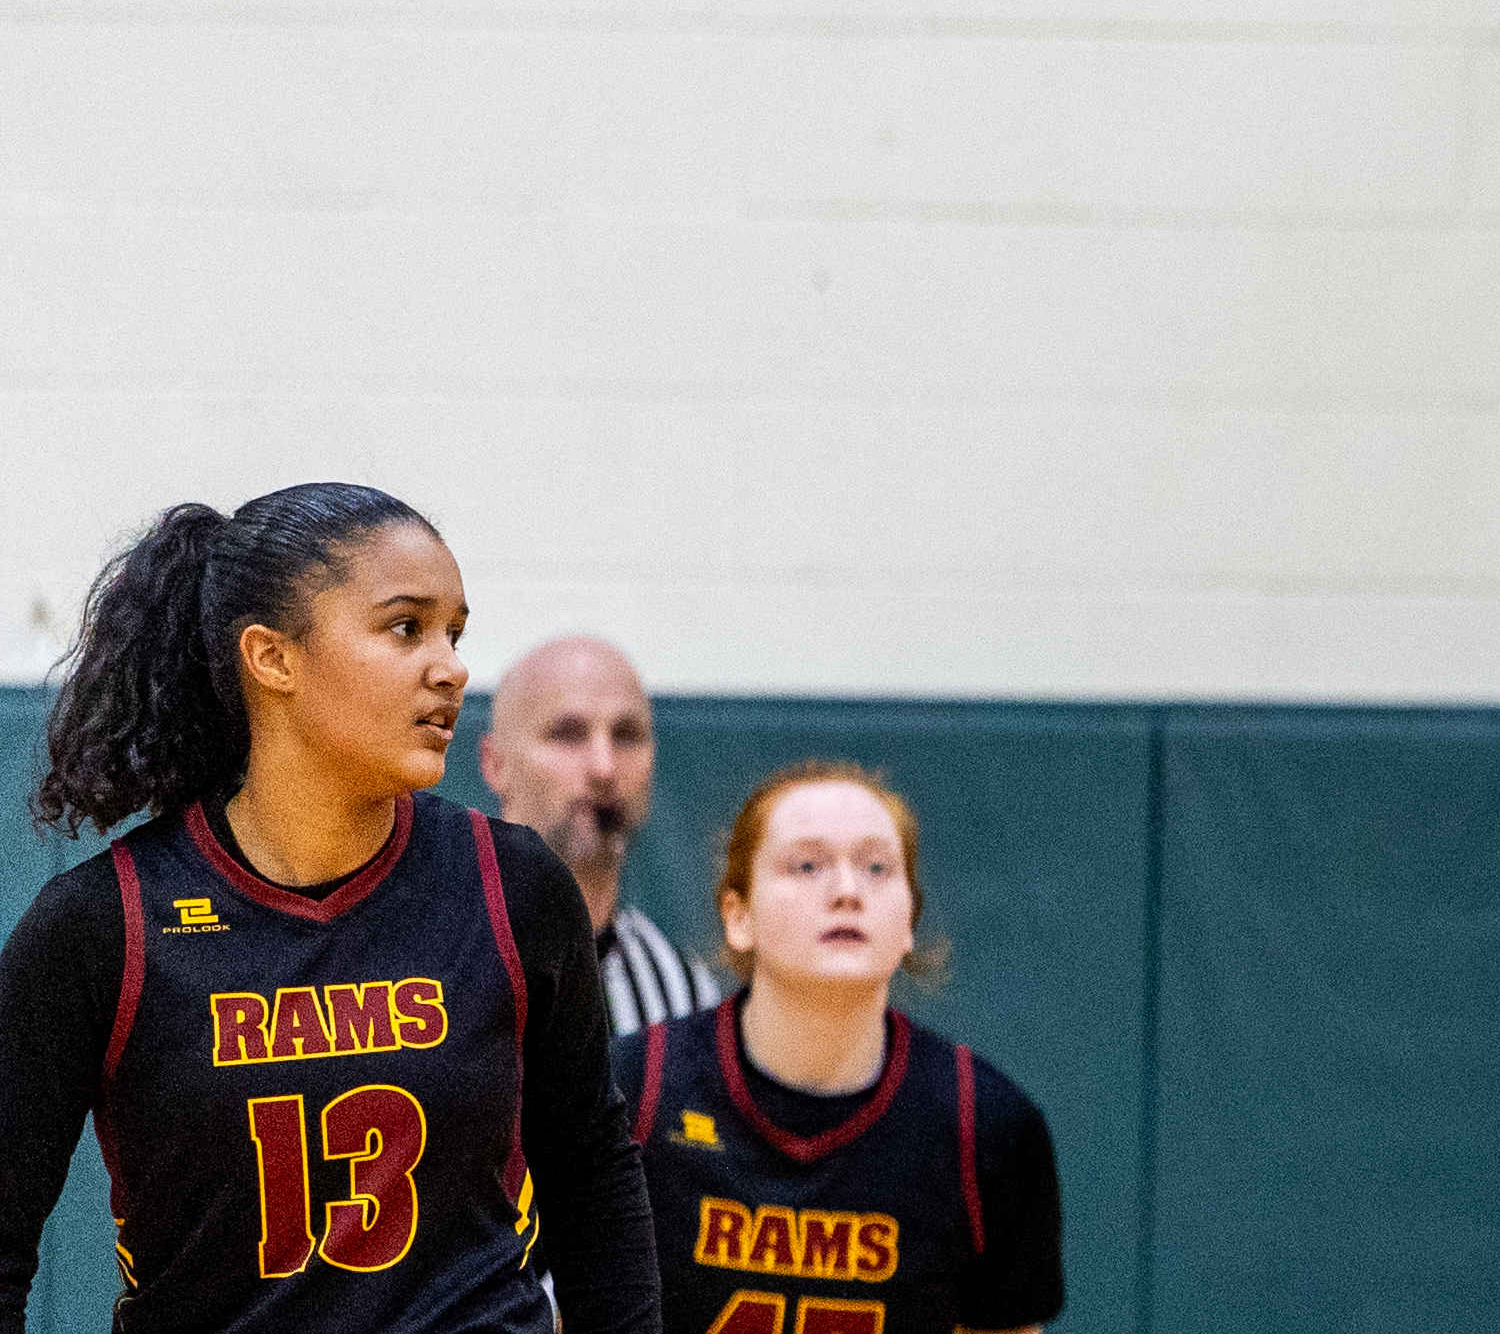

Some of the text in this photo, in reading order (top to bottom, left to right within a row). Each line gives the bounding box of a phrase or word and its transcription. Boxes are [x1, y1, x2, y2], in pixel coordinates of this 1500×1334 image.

[162, 924, 231, 935] PROLOOK
[210, 977, 448, 1067] RAMS
[247, 1083, 427, 1278] 13
[693, 1197, 899, 1283] RAMS
